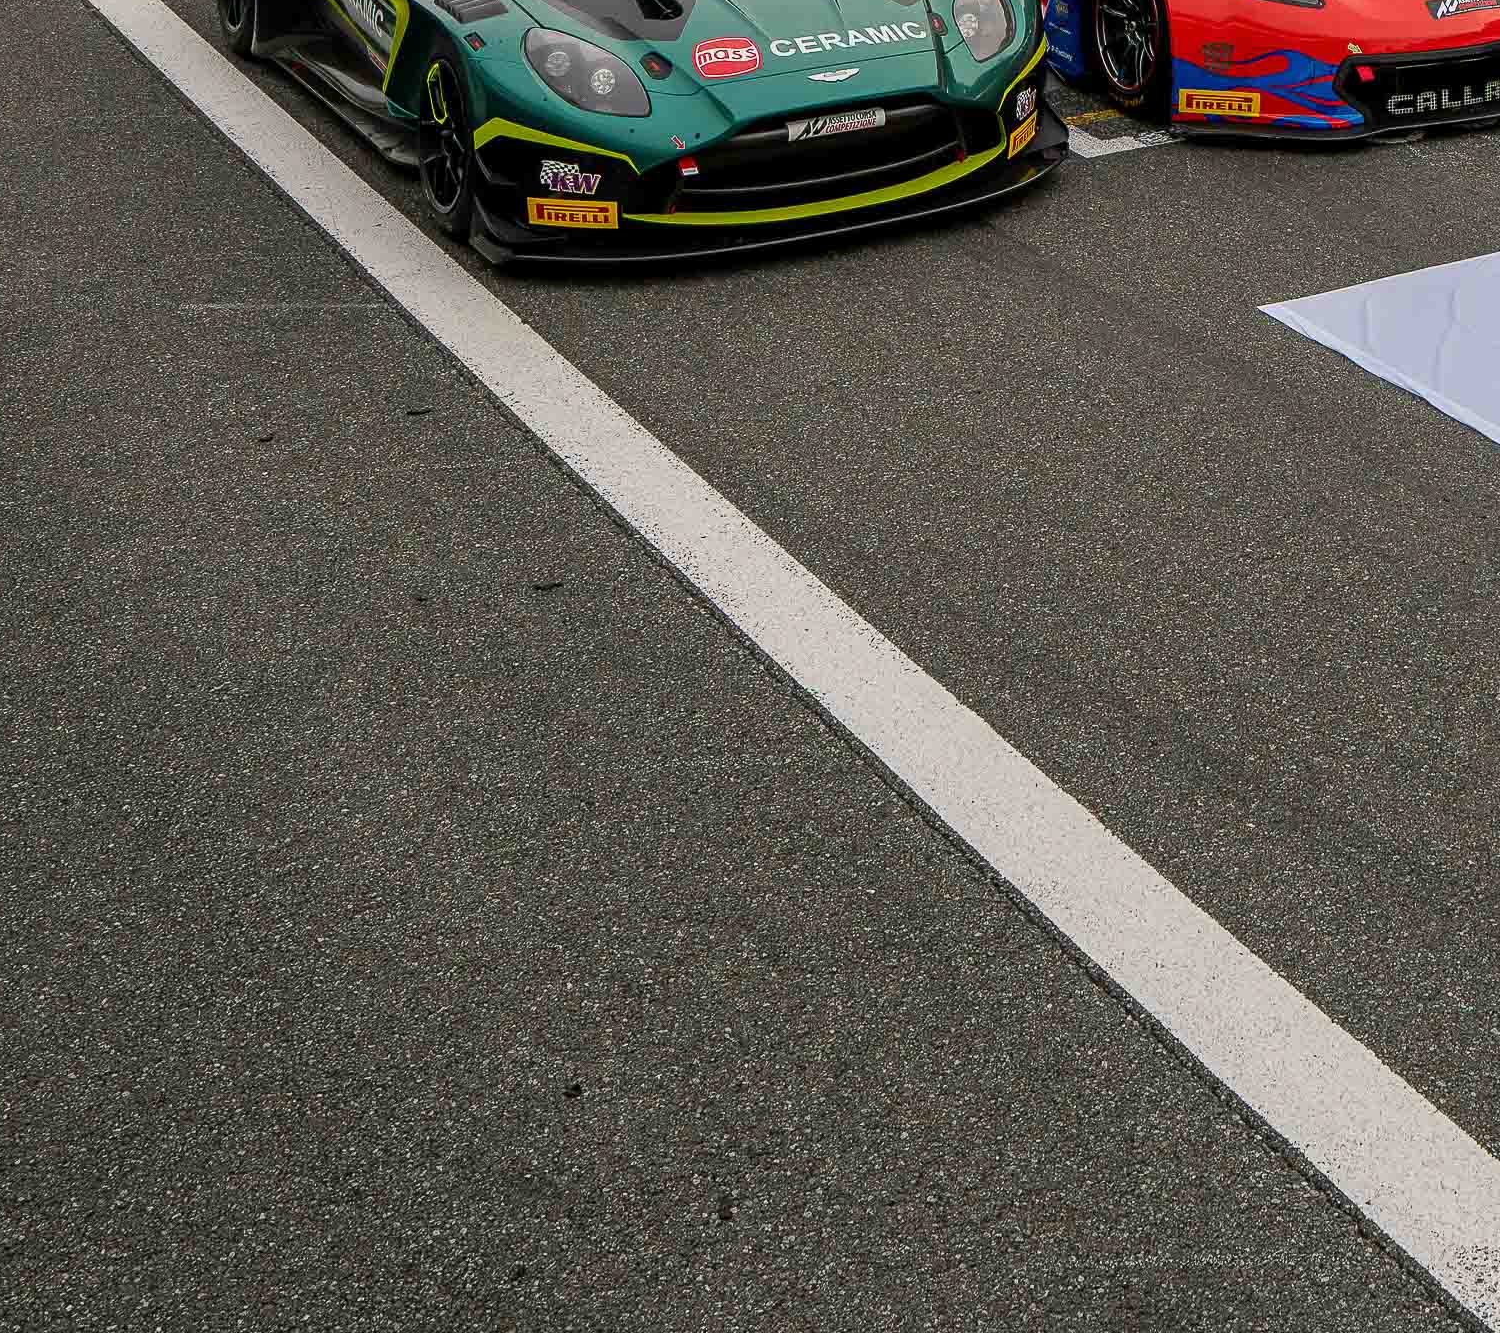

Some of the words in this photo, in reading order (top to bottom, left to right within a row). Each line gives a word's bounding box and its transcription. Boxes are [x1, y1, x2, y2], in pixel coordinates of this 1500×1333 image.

[699, 45, 758, 65] mass
[769, 20, 928, 61] CERAMIC
[1187, 93, 1255, 114] PIRELLI
[1011, 119, 1036, 157] PIRELLI
[548, 168, 601, 195] KW
[534, 205, 613, 227] PIRELLI
